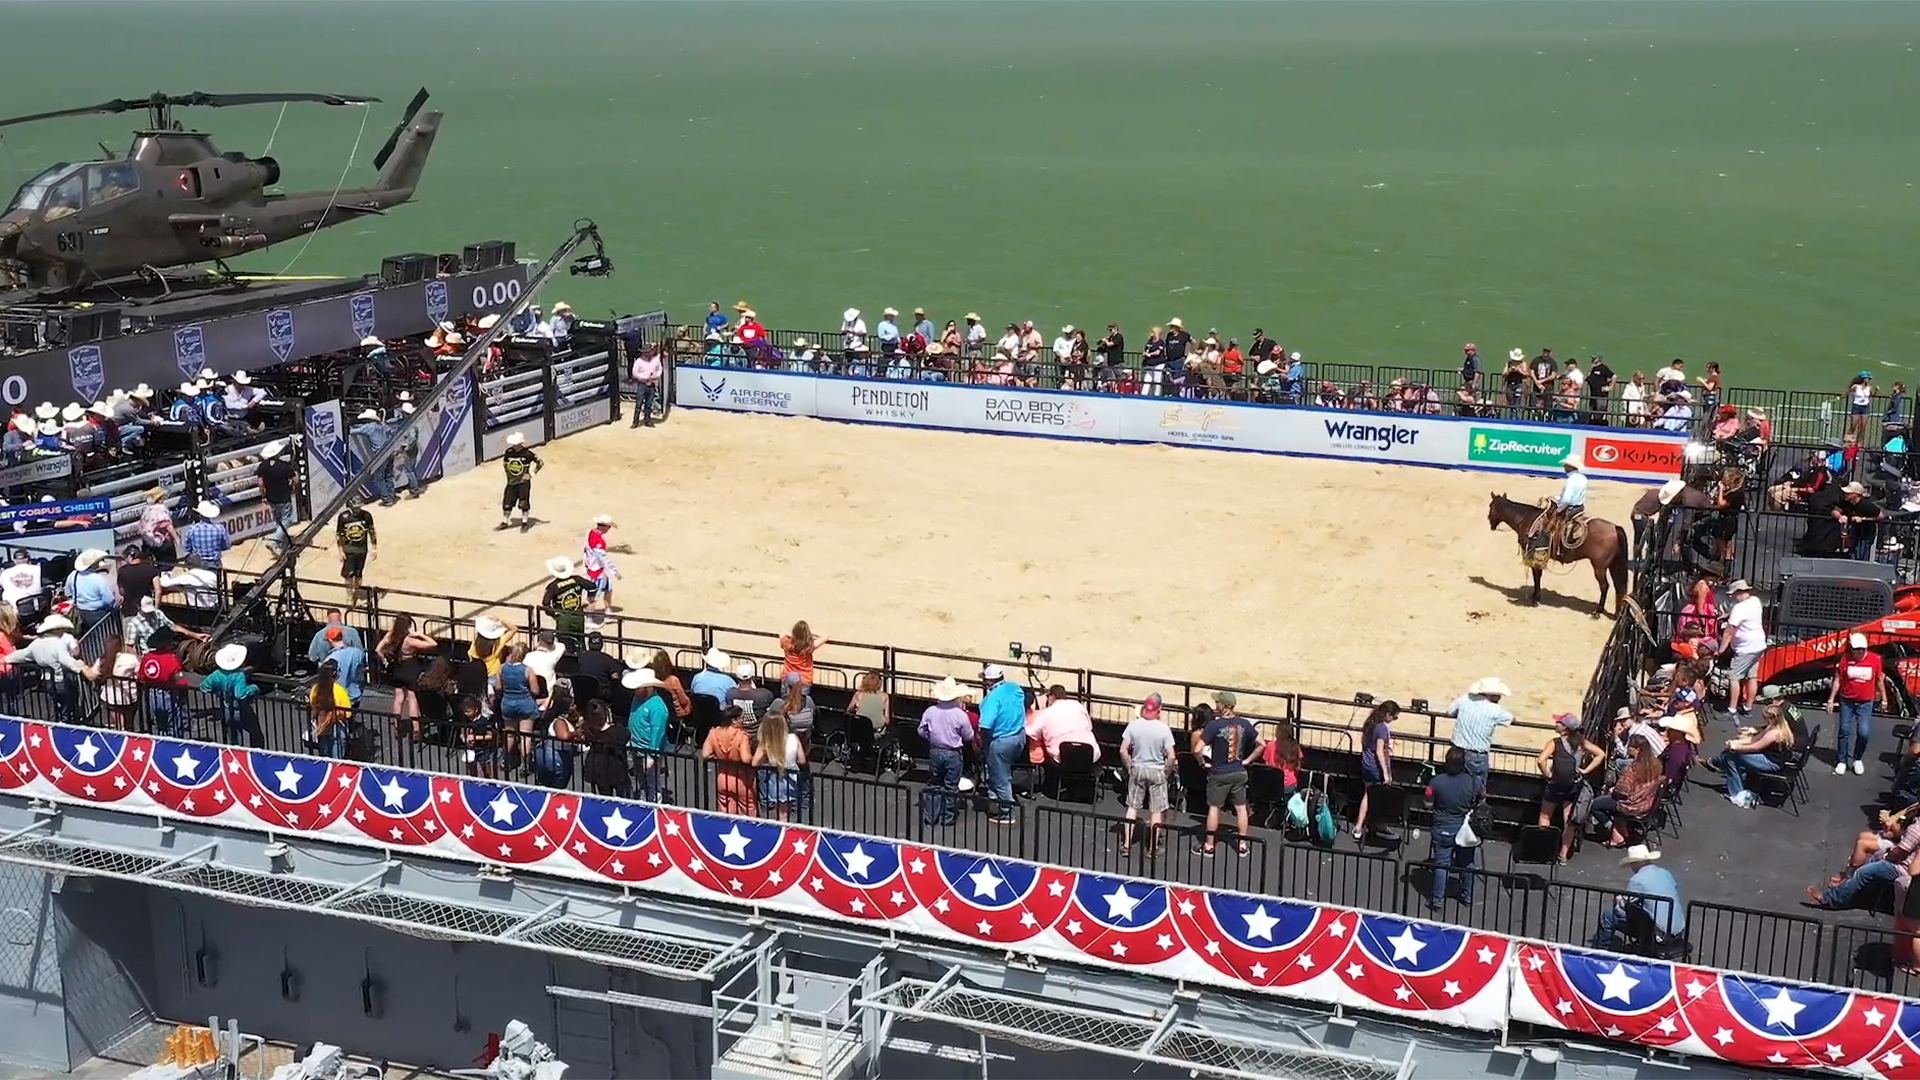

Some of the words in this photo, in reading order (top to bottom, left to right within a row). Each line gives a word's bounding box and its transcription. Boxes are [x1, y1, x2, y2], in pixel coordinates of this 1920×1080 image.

[472, 278, 521, 308] 0.00
[730, 388, 751, 397] AIR
[754, 390, 792, 400] FORCE
[734, 397, 789, 408] RESERVE
[986, 398, 1022, 411] BAD
[1029, 400, 1065, 412] BOY
[865, 408, 916, 419] WHISKY
[985, 410, 1065, 426] MOWERS
[1324, 419, 1419, 451] Wrangler
[1488, 438, 1563, 456] ZipRecruiter
[35, 459, 69, 474] Wrangler
[19, 506, 62, 517] CORPUS
[63, 501, 105, 513] CHRISTI
